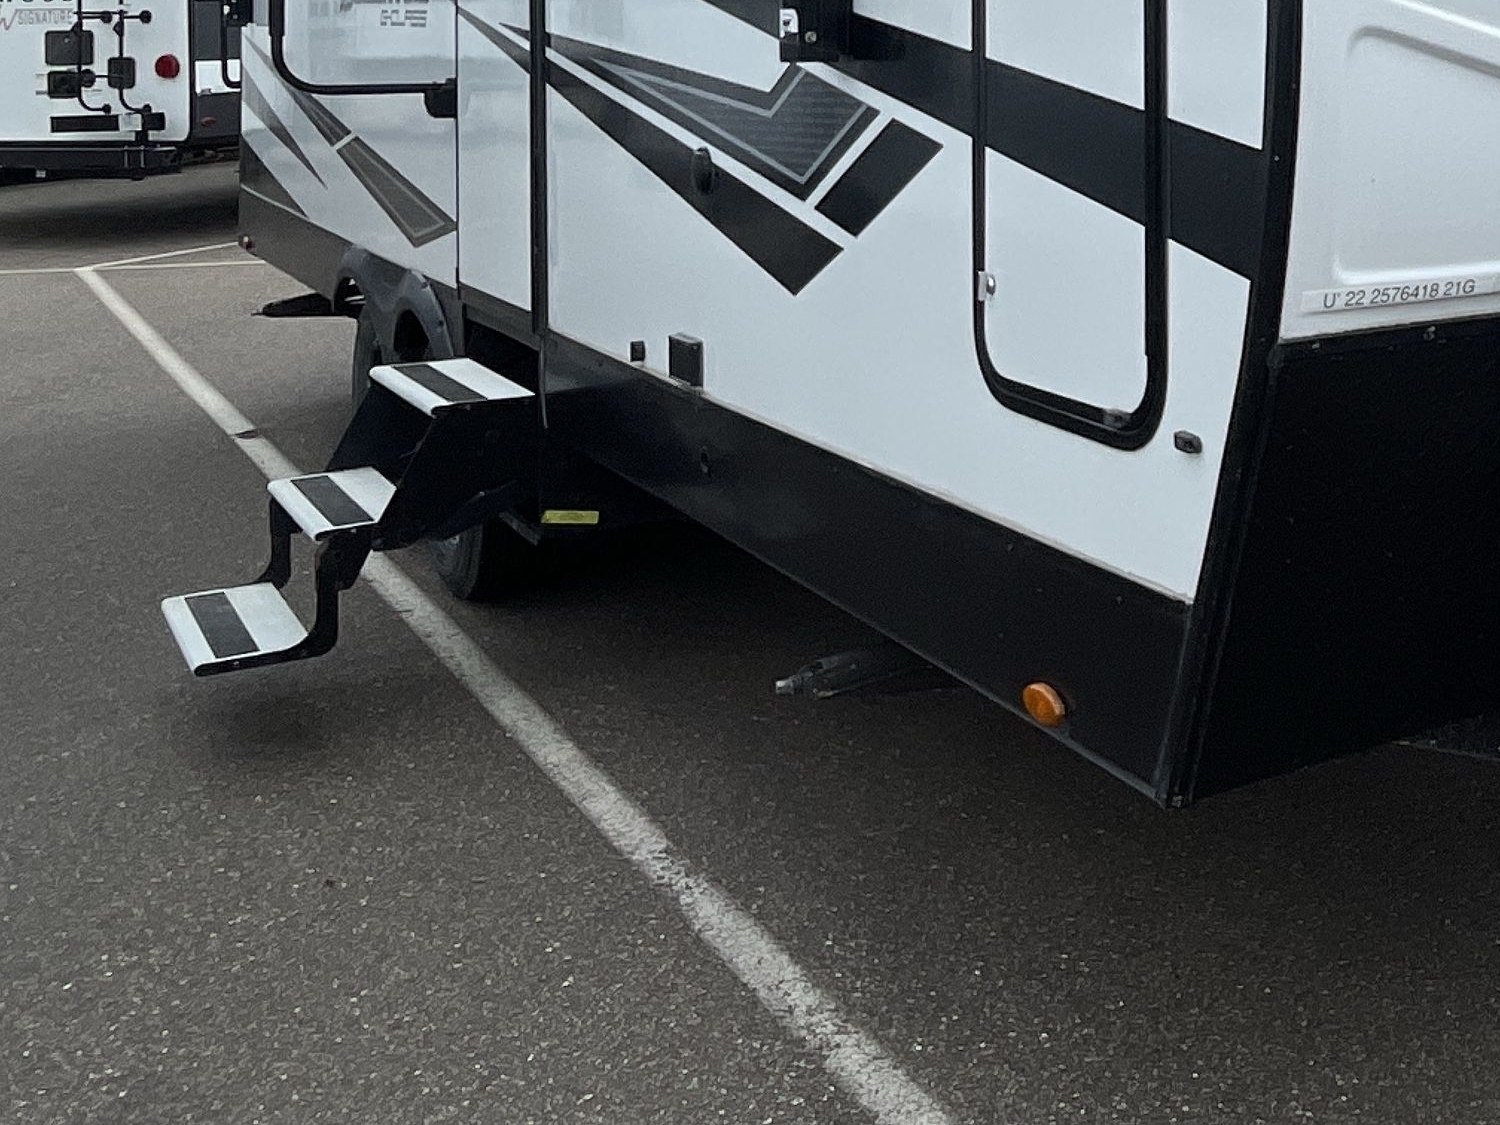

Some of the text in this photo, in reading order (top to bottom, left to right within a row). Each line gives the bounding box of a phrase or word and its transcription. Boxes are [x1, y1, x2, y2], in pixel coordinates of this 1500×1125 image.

[1344, 290, 1366, 307] 22
[1370, 282, 1440, 304] 2576418
[1443, 279, 1477, 296] 21G
